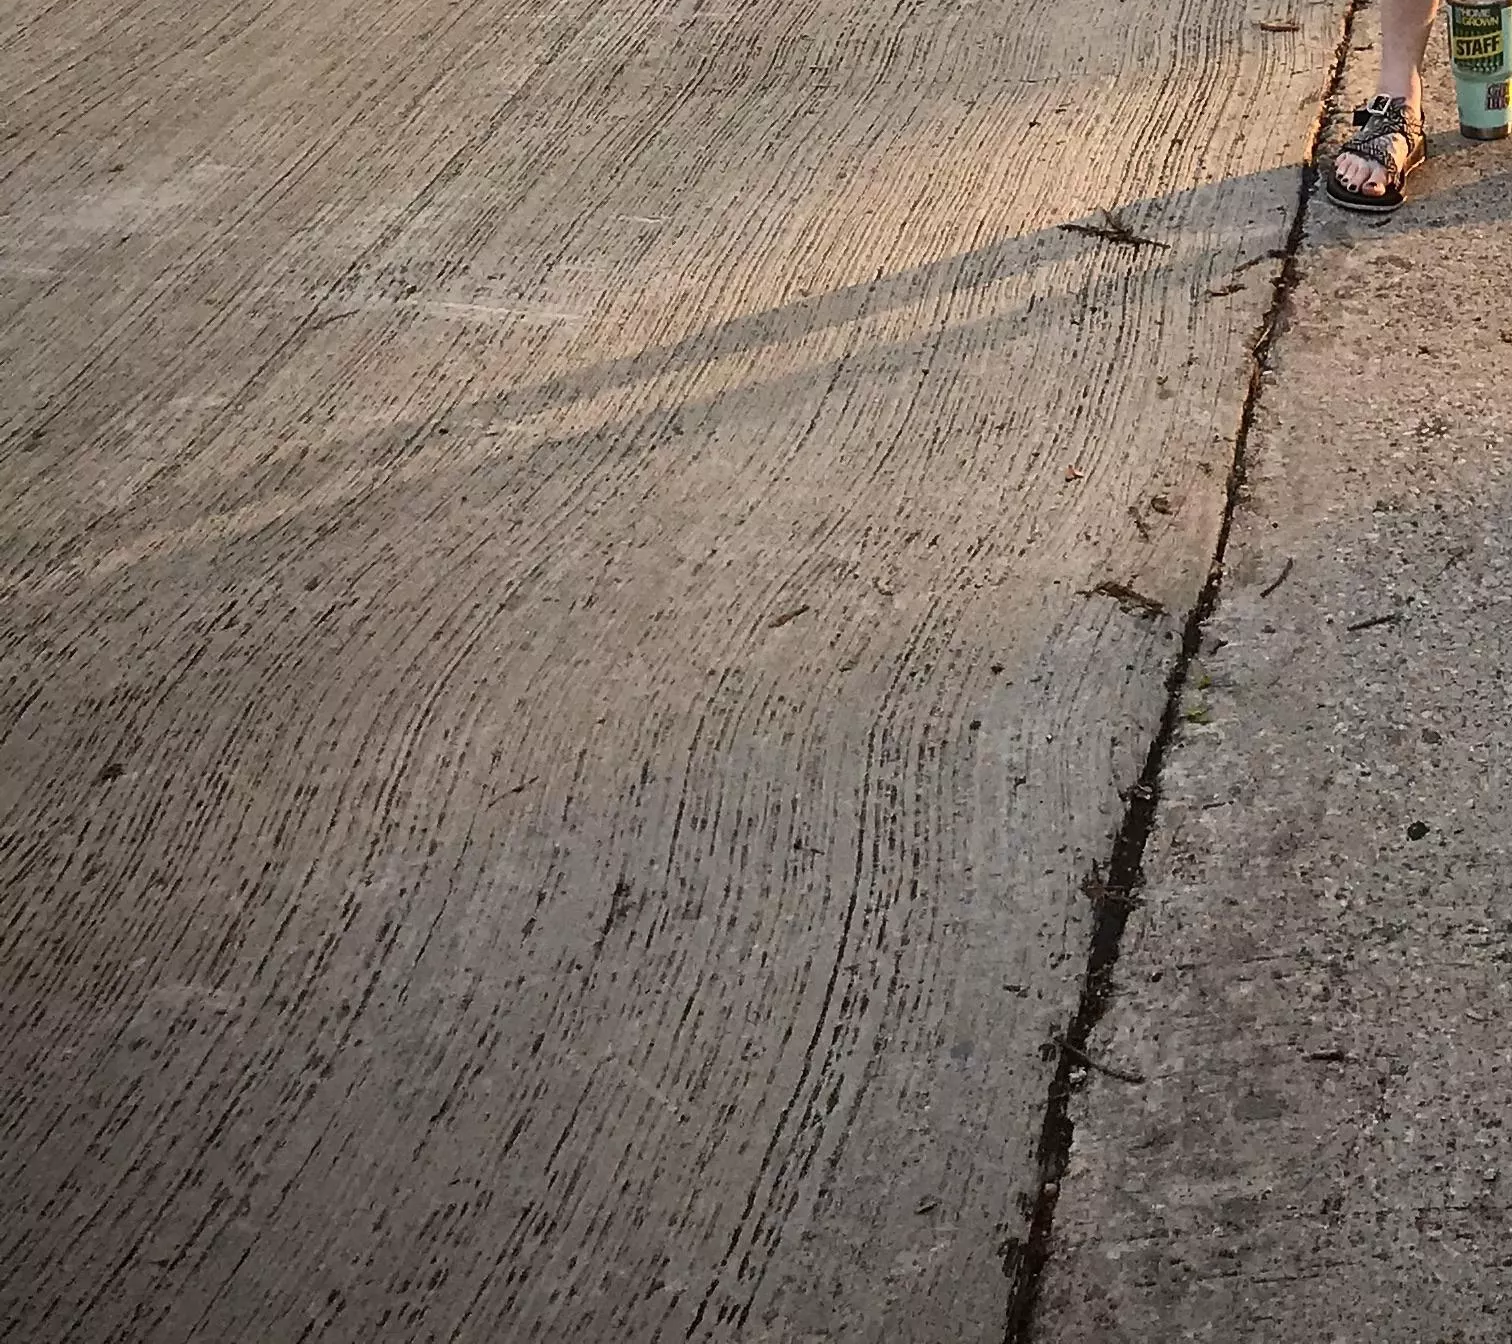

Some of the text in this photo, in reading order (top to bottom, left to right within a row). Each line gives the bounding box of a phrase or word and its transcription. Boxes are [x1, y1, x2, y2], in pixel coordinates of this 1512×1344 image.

[1461, 7, 1491, 17] HOME
[1463, 16, 1499, 26] GROWN
[1456, 35, 1500, 56] STAFF
